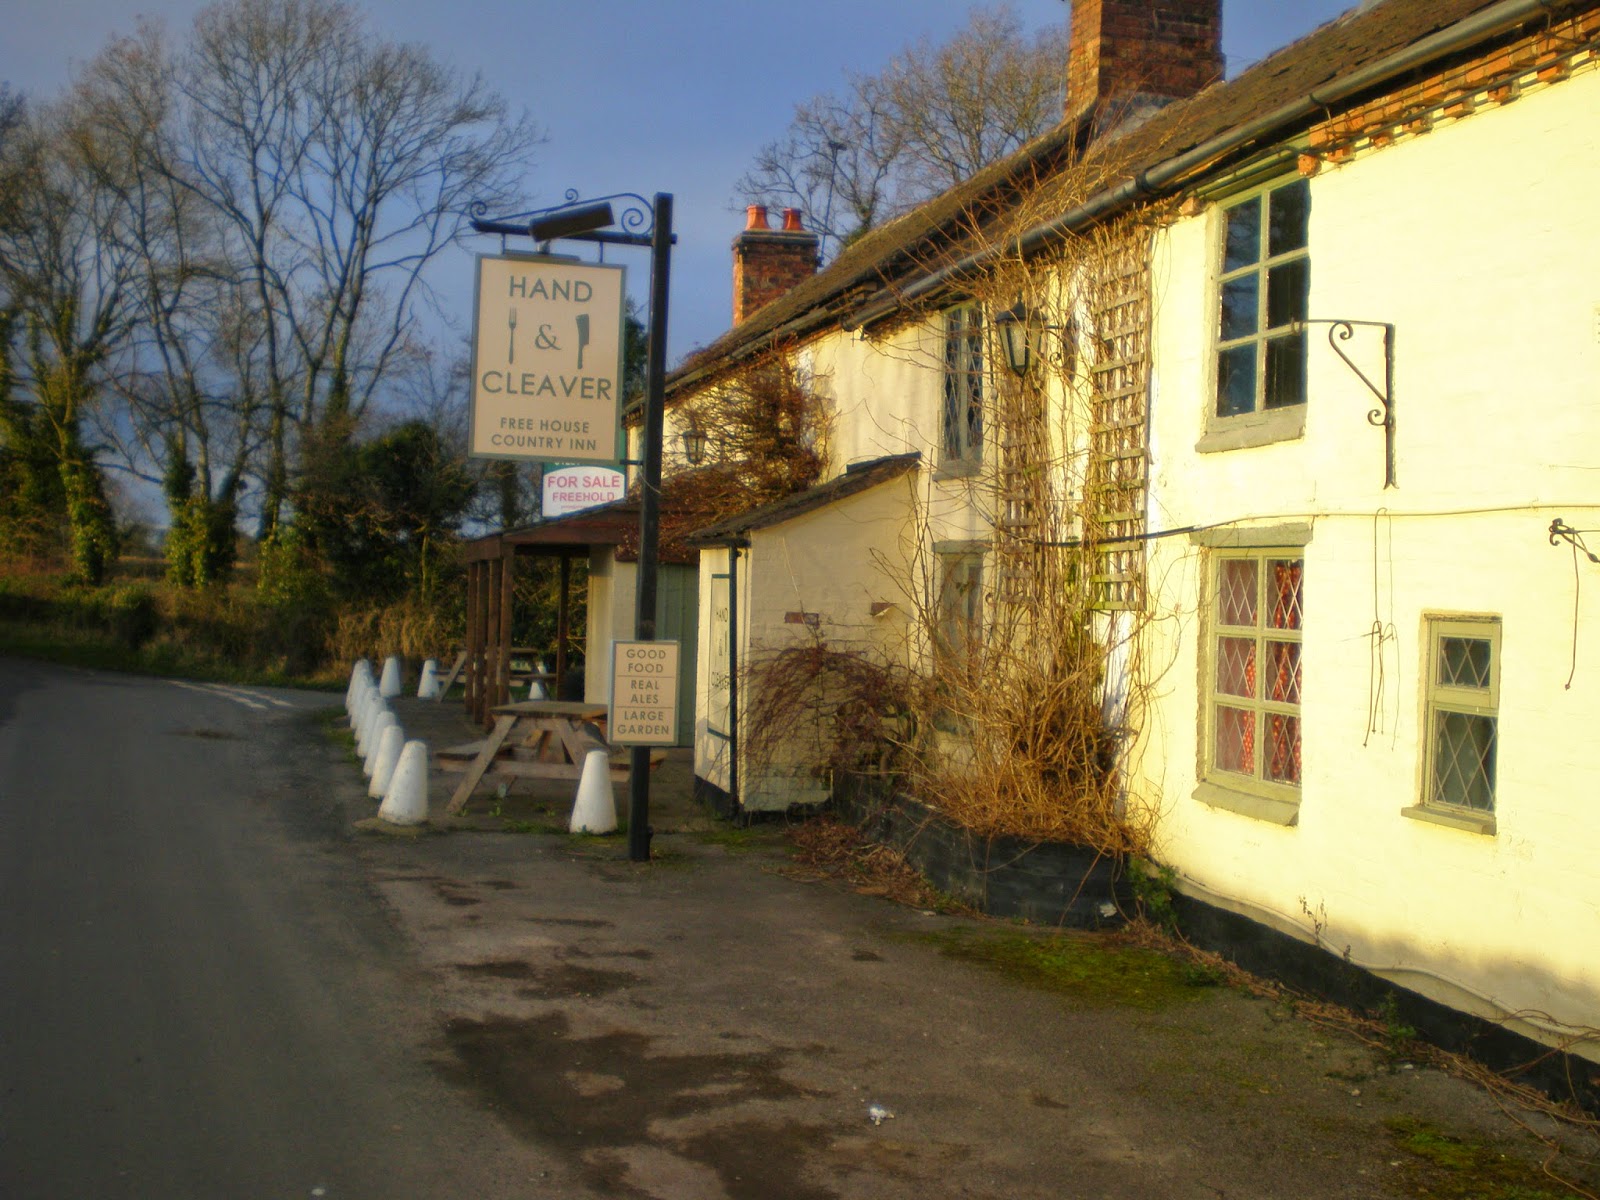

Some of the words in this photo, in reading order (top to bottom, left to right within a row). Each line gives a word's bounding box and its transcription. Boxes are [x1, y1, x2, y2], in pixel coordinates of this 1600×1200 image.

[508, 275, 593, 303] HAND
[534, 323, 562, 350] &
[482, 370, 612, 400] CLEAVER
[500, 417, 534, 430] FREE
[540, 420, 590, 434] HOUSE
[491, 434, 563, 449] COUNTRY
[569, 438, 597, 450] INN
[547, 476, 578, 488] FOR
[582, 475, 620, 488] SALE
[552, 492, 615, 502] FREEHOLD
[626, 648, 666, 660] GOOD
[627, 663, 664, 673] FOOD
[630, 680, 660, 690] REAL
[630, 694, 659, 704] ALES
[624, 711, 664, 721] LARGE
[617, 724, 669, 735] GARDEN
